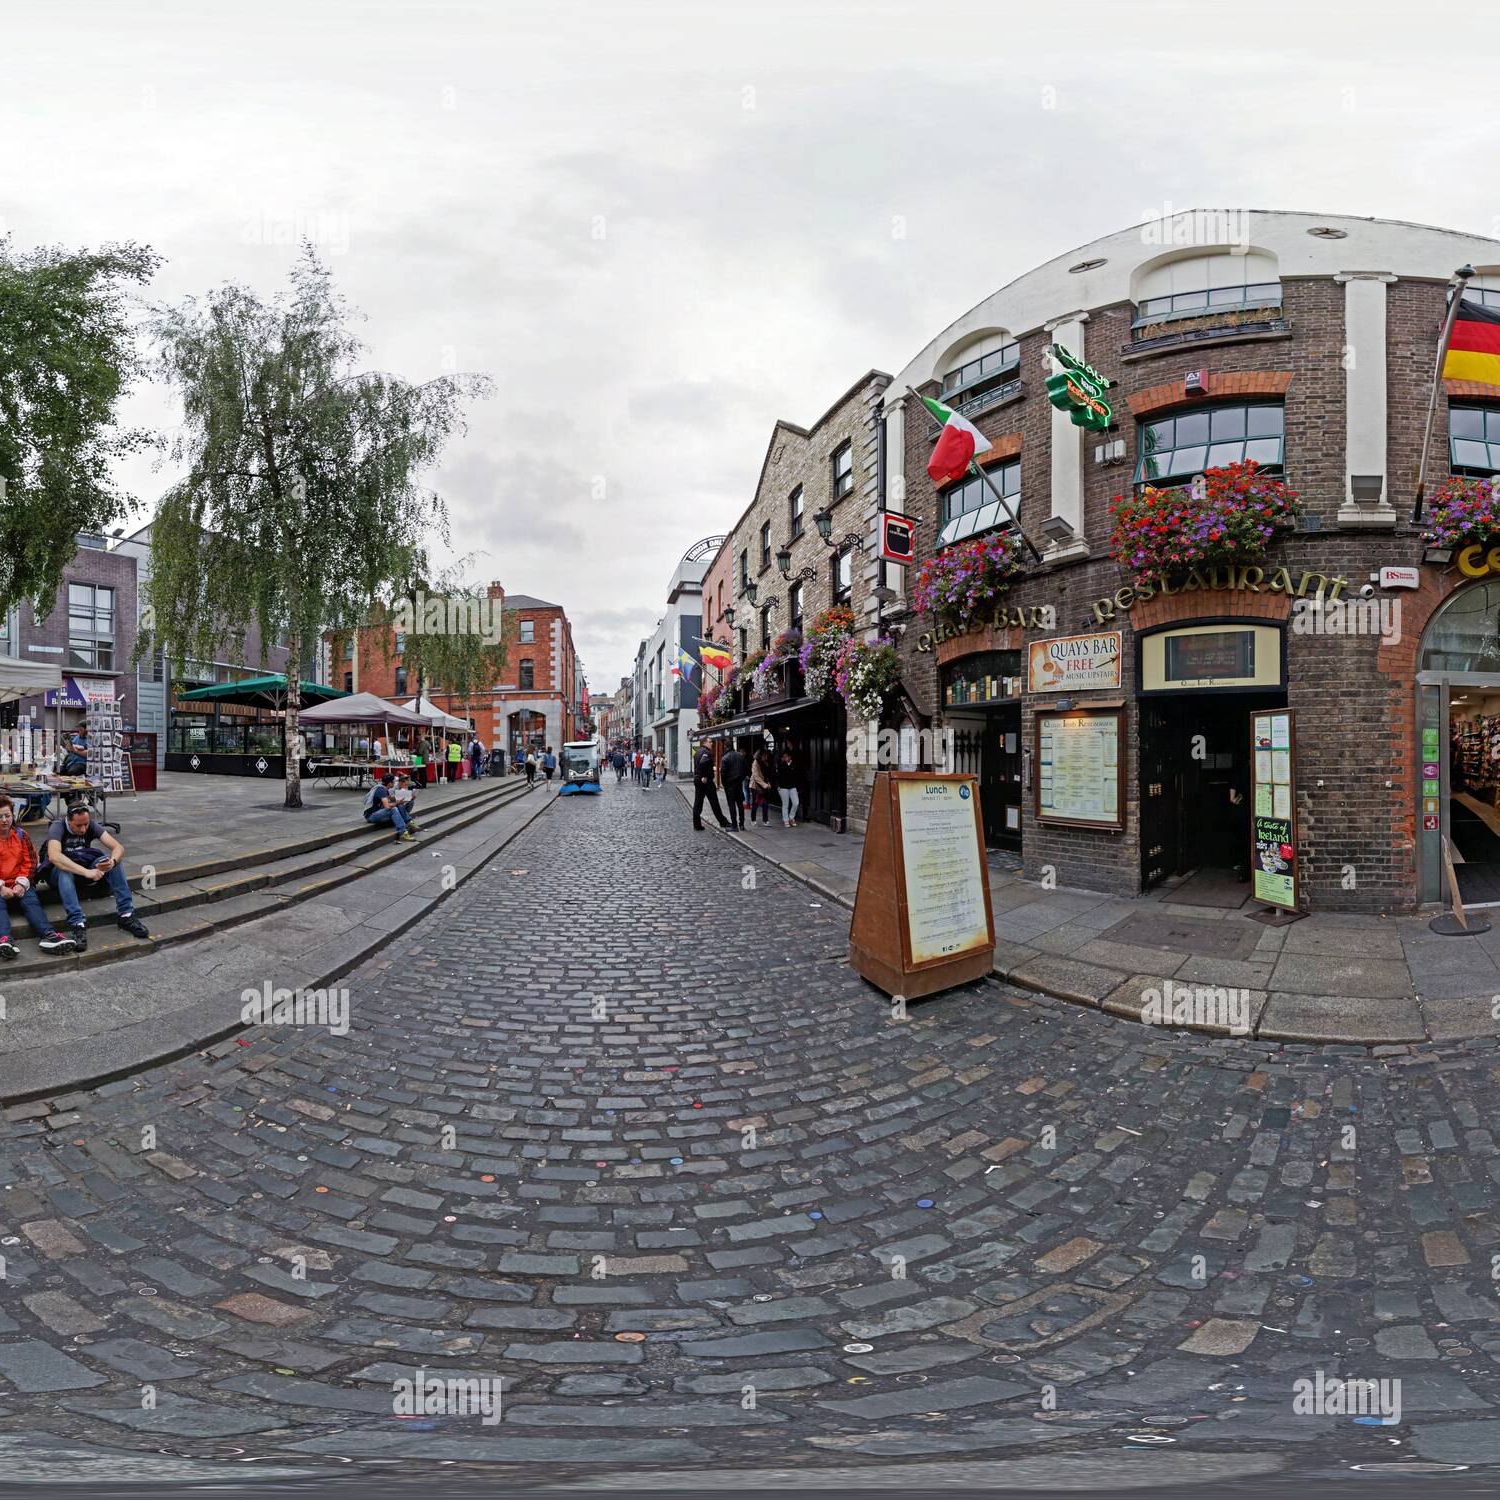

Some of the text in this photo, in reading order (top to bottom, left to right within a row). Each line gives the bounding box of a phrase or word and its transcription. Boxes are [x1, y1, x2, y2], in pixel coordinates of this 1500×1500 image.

[916, 606, 1047, 652] QUAYS BAR
[1050, 637, 1118, 660] QUAYS BAR
[1067, 658, 1094, 672] FREE
[1065, 672, 1085, 681] MUSIC
[1087, 670, 1118, 679] UPSTAIRS
[925, 785, 948, 795] Lunch
